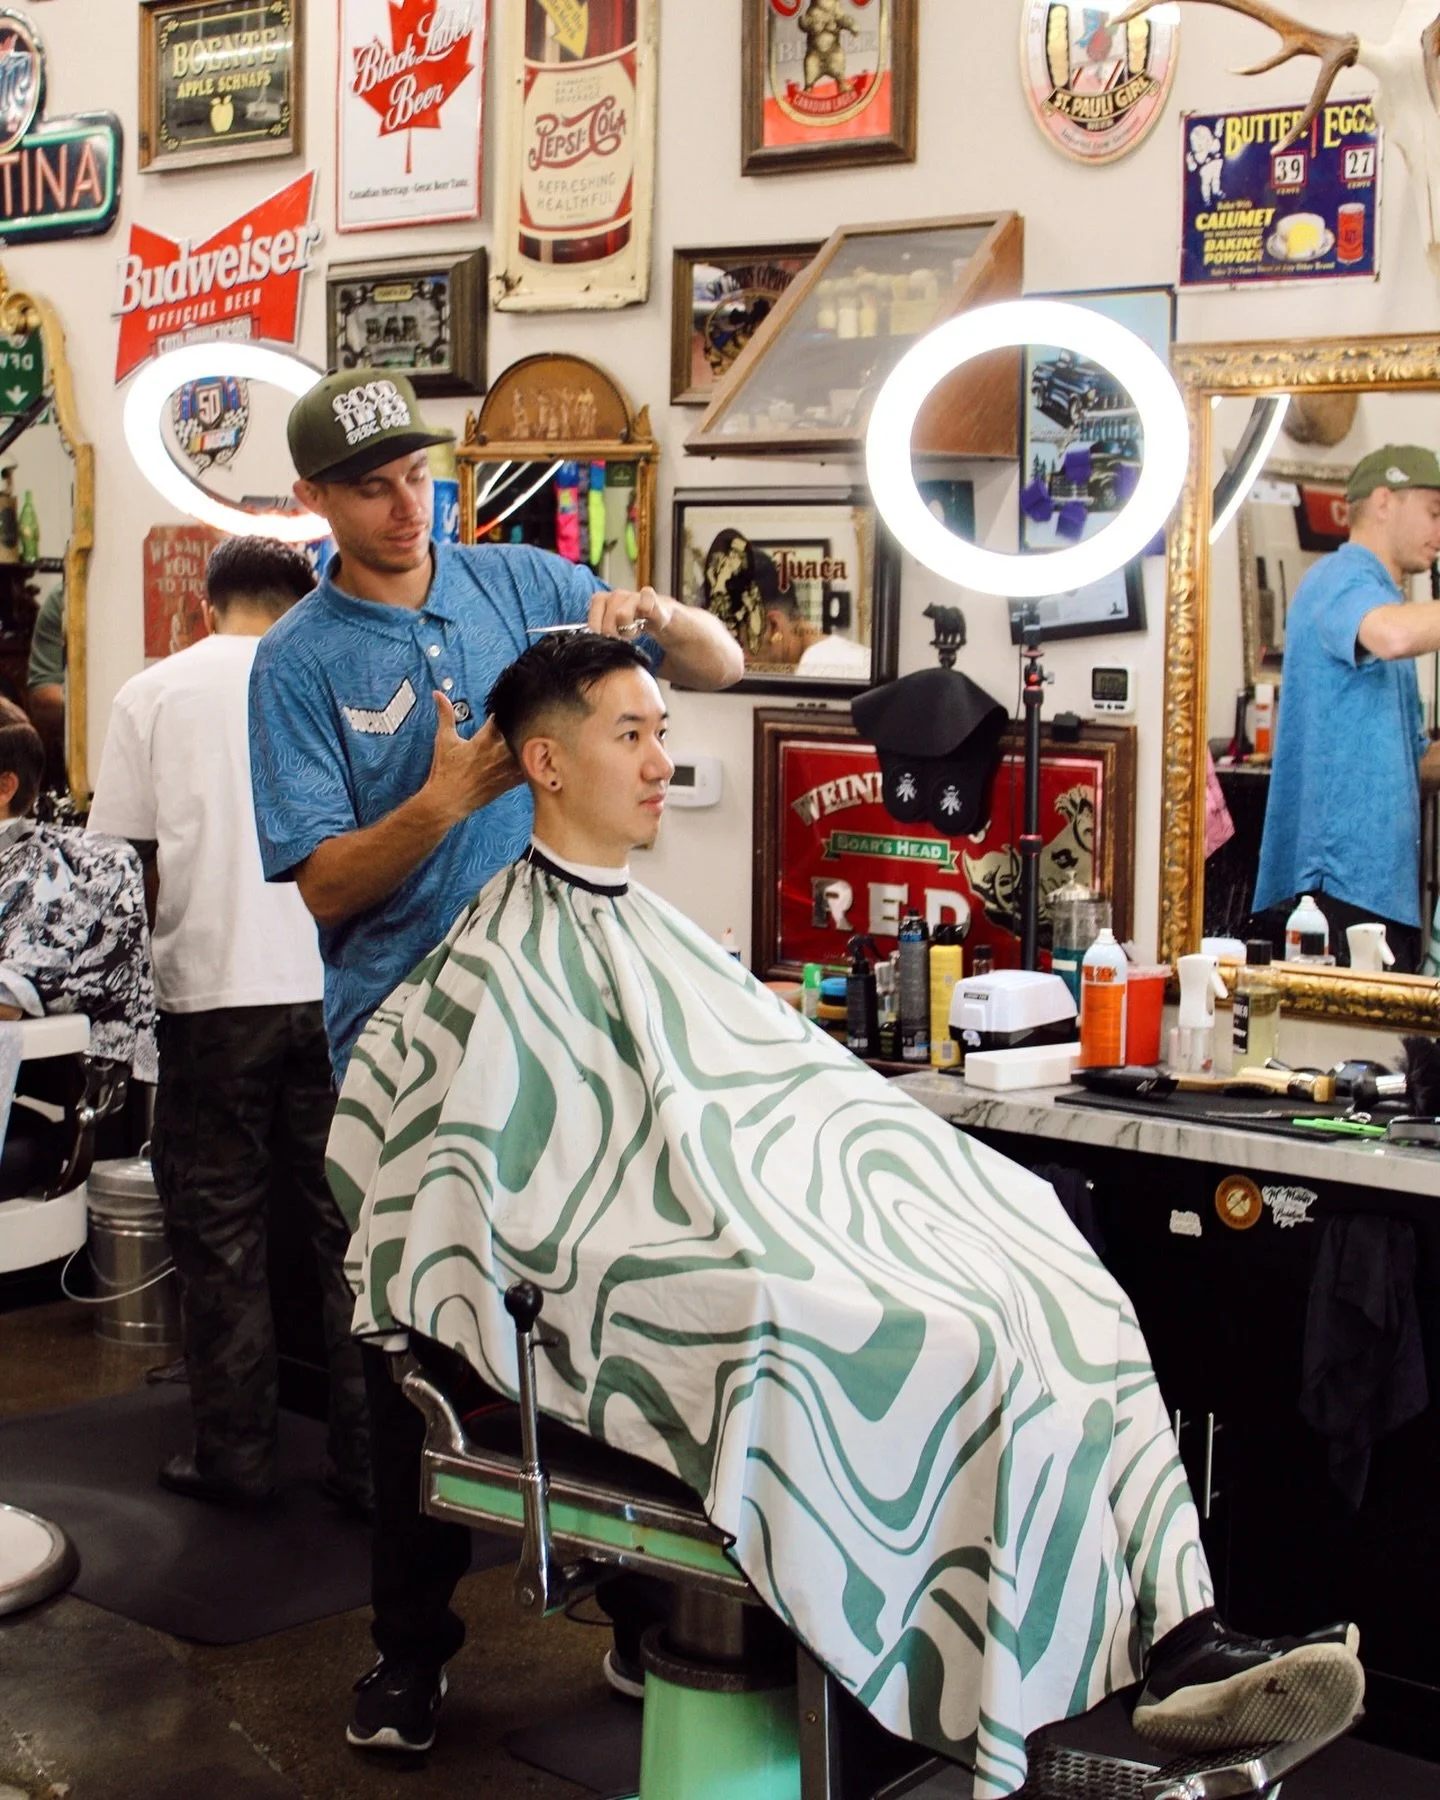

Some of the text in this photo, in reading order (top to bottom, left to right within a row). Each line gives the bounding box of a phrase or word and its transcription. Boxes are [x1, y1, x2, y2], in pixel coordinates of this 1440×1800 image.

[352, 4, 474, 95] Black Label
[176, 70, 271, 99] APPLE SCHNAPS
[1053, 74, 1150, 118] ST. PAULI GIRL
[386, 73, 445, 129] Beer
[794, 93, 832, 113] CANADIAN
[1323, 103, 1377, 148] EGGS
[1277, 158, 1301, 181] 39
[1348, 151, 1370, 174] 27
[538, 171, 616, 194] REFRESHING
[537, 190, 615, 212] HEALTHFUL
[1195, 208, 1276, 232] CALUMET
[1203, 249, 1264, 266] POWDER
[1204, 236, 1263, 252] BAKING
[112, 224, 320, 317] Budweiser
[147, 288, 262, 331] OFFICIAL BEER
[365, 315, 420, 343] BAR
[199, 387, 221, 425] 50
[332, 380, 398, 415] GOOD
[164, 556, 198, 576] YOU
[772, 549, 848, 592] Tuaca
[155, 578, 176, 593] TO
[791, 771, 884, 826] WEIN
[837, 834, 942, 858] BOAR'S HEAD
[811, 876, 970, 941] RED
